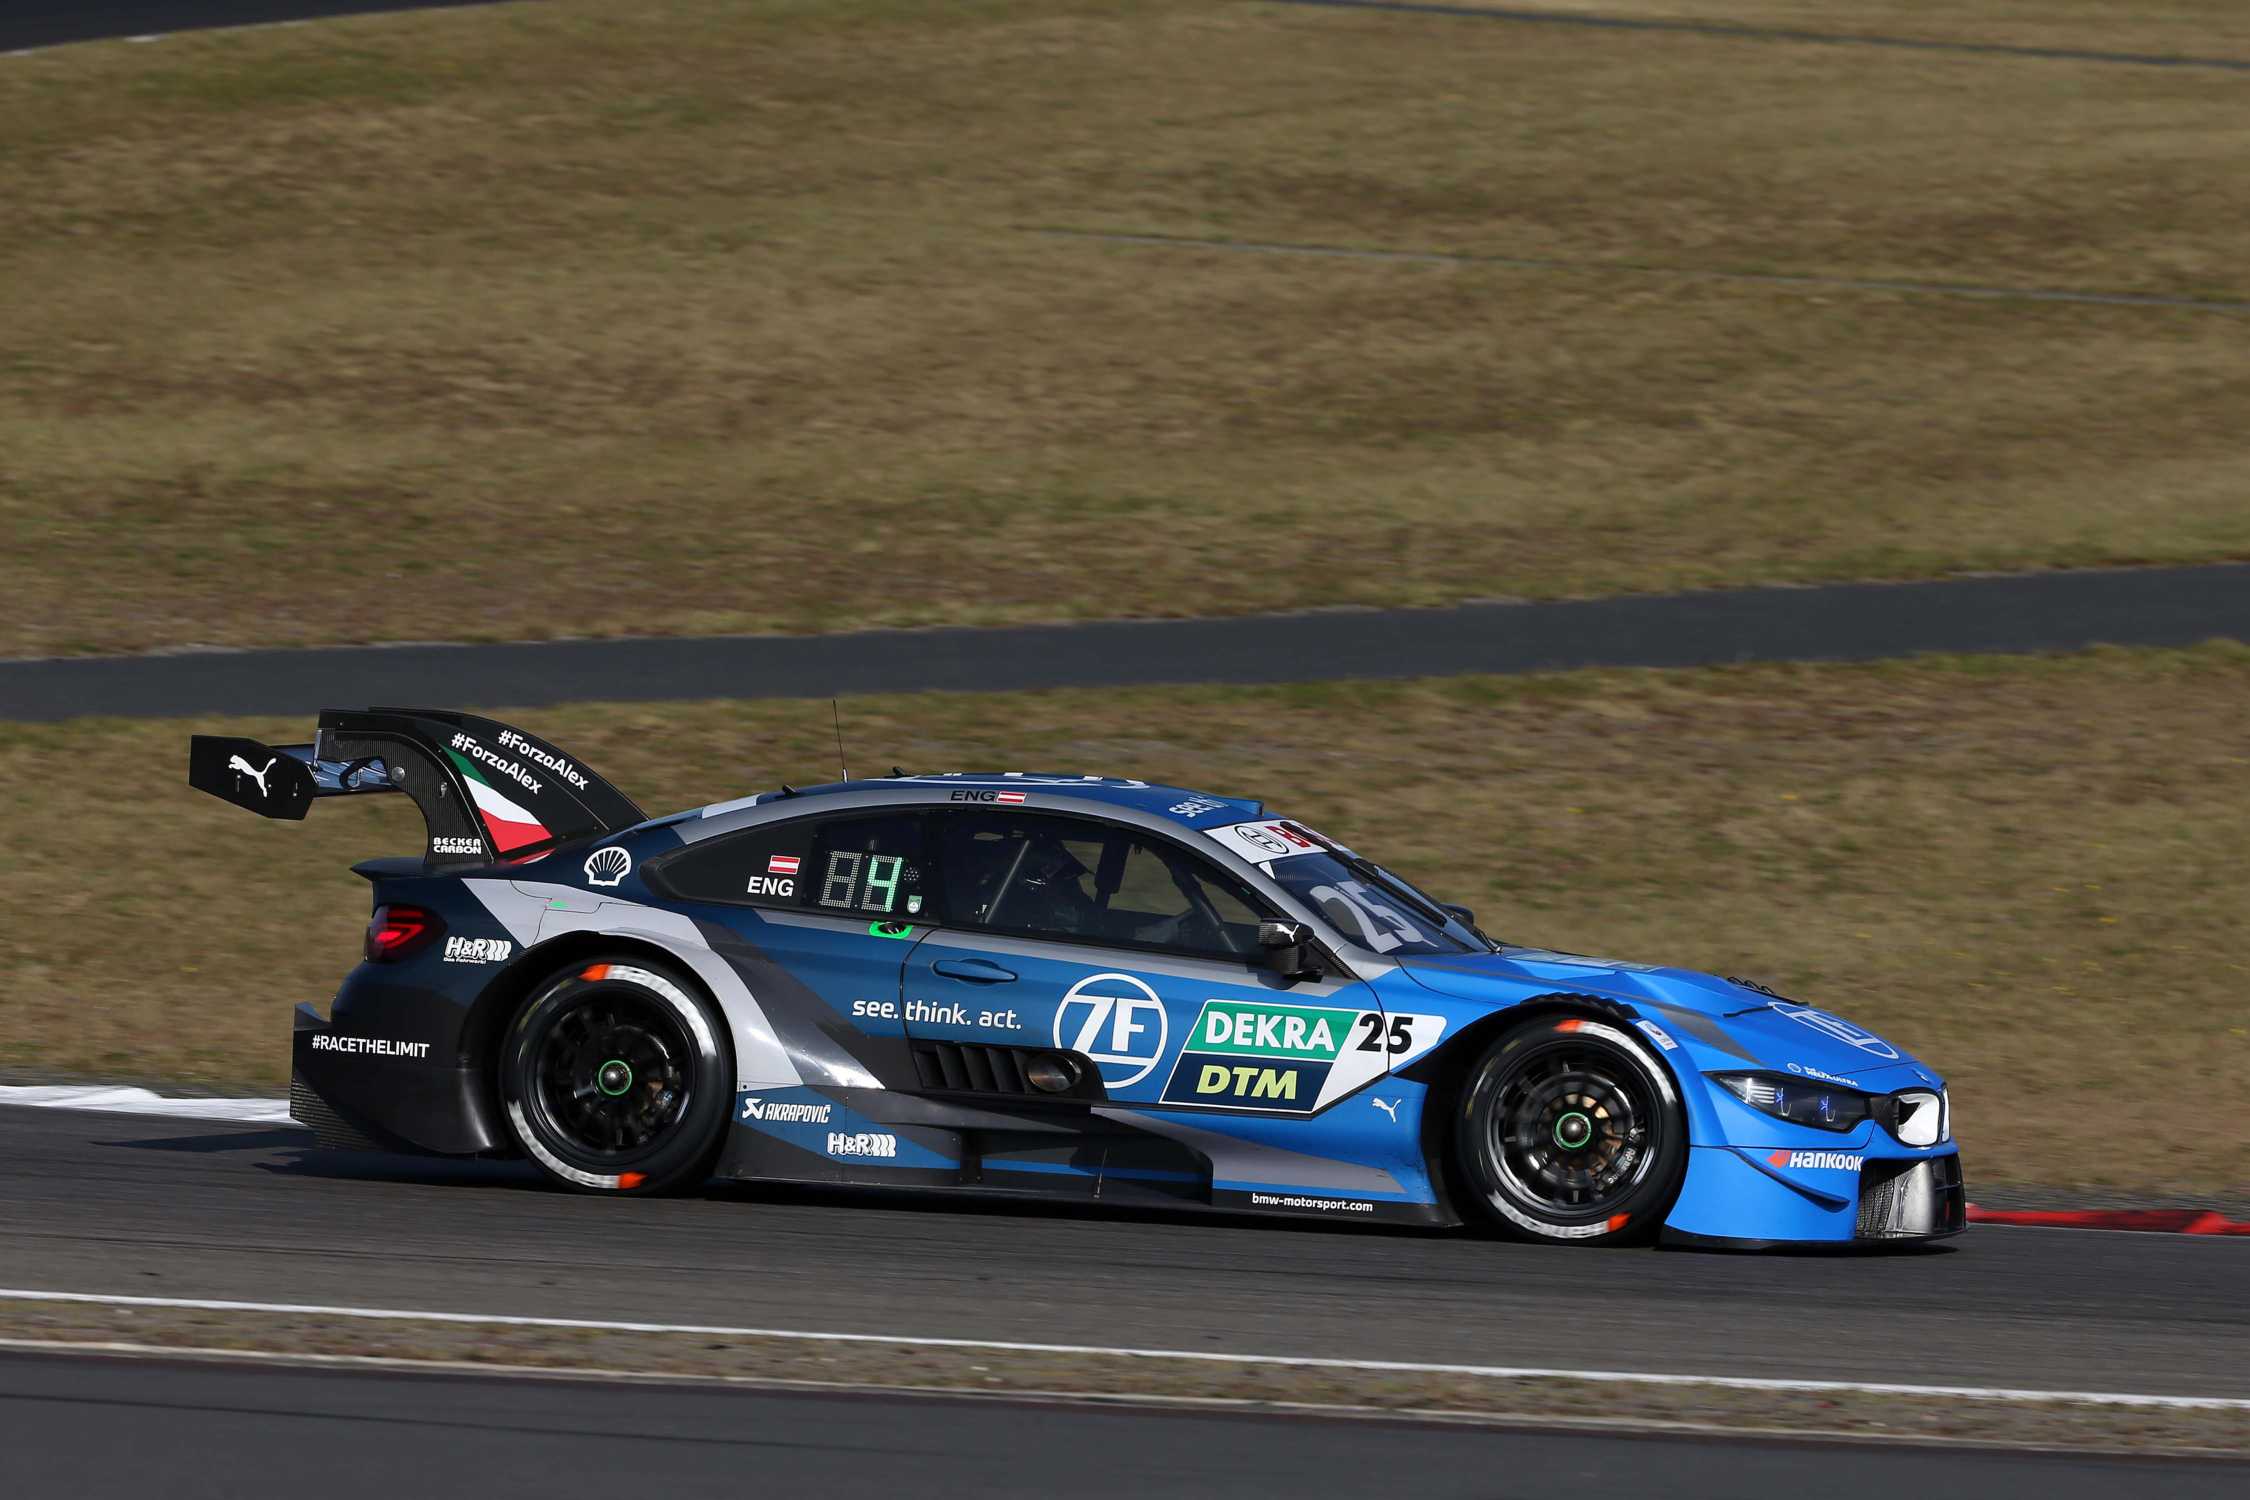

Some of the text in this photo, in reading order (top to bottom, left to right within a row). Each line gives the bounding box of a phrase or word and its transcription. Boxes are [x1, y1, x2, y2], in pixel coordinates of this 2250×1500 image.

[451, 732, 543, 796] #ForzaAlex
[497, 730, 589, 792] #ForzaAlex
[950, 789, 997, 802] ENG
[433, 837, 481, 847] BECKER
[433, 845, 482, 855] CARBON
[746, 875, 795, 897] ENG
[852, 998, 1022, 1030] see. think. act.
[1205, 1011, 1336, 1053] DEKRA
[1356, 1013, 1414, 1055] 25
[311, 1034, 431, 1058] #RACETHELIMIT
[1195, 1064, 1299, 1100] DTM
[827, 1132, 873, 1157] H&R
[1251, 1192, 1374, 1212] bmw-motorsport.com
